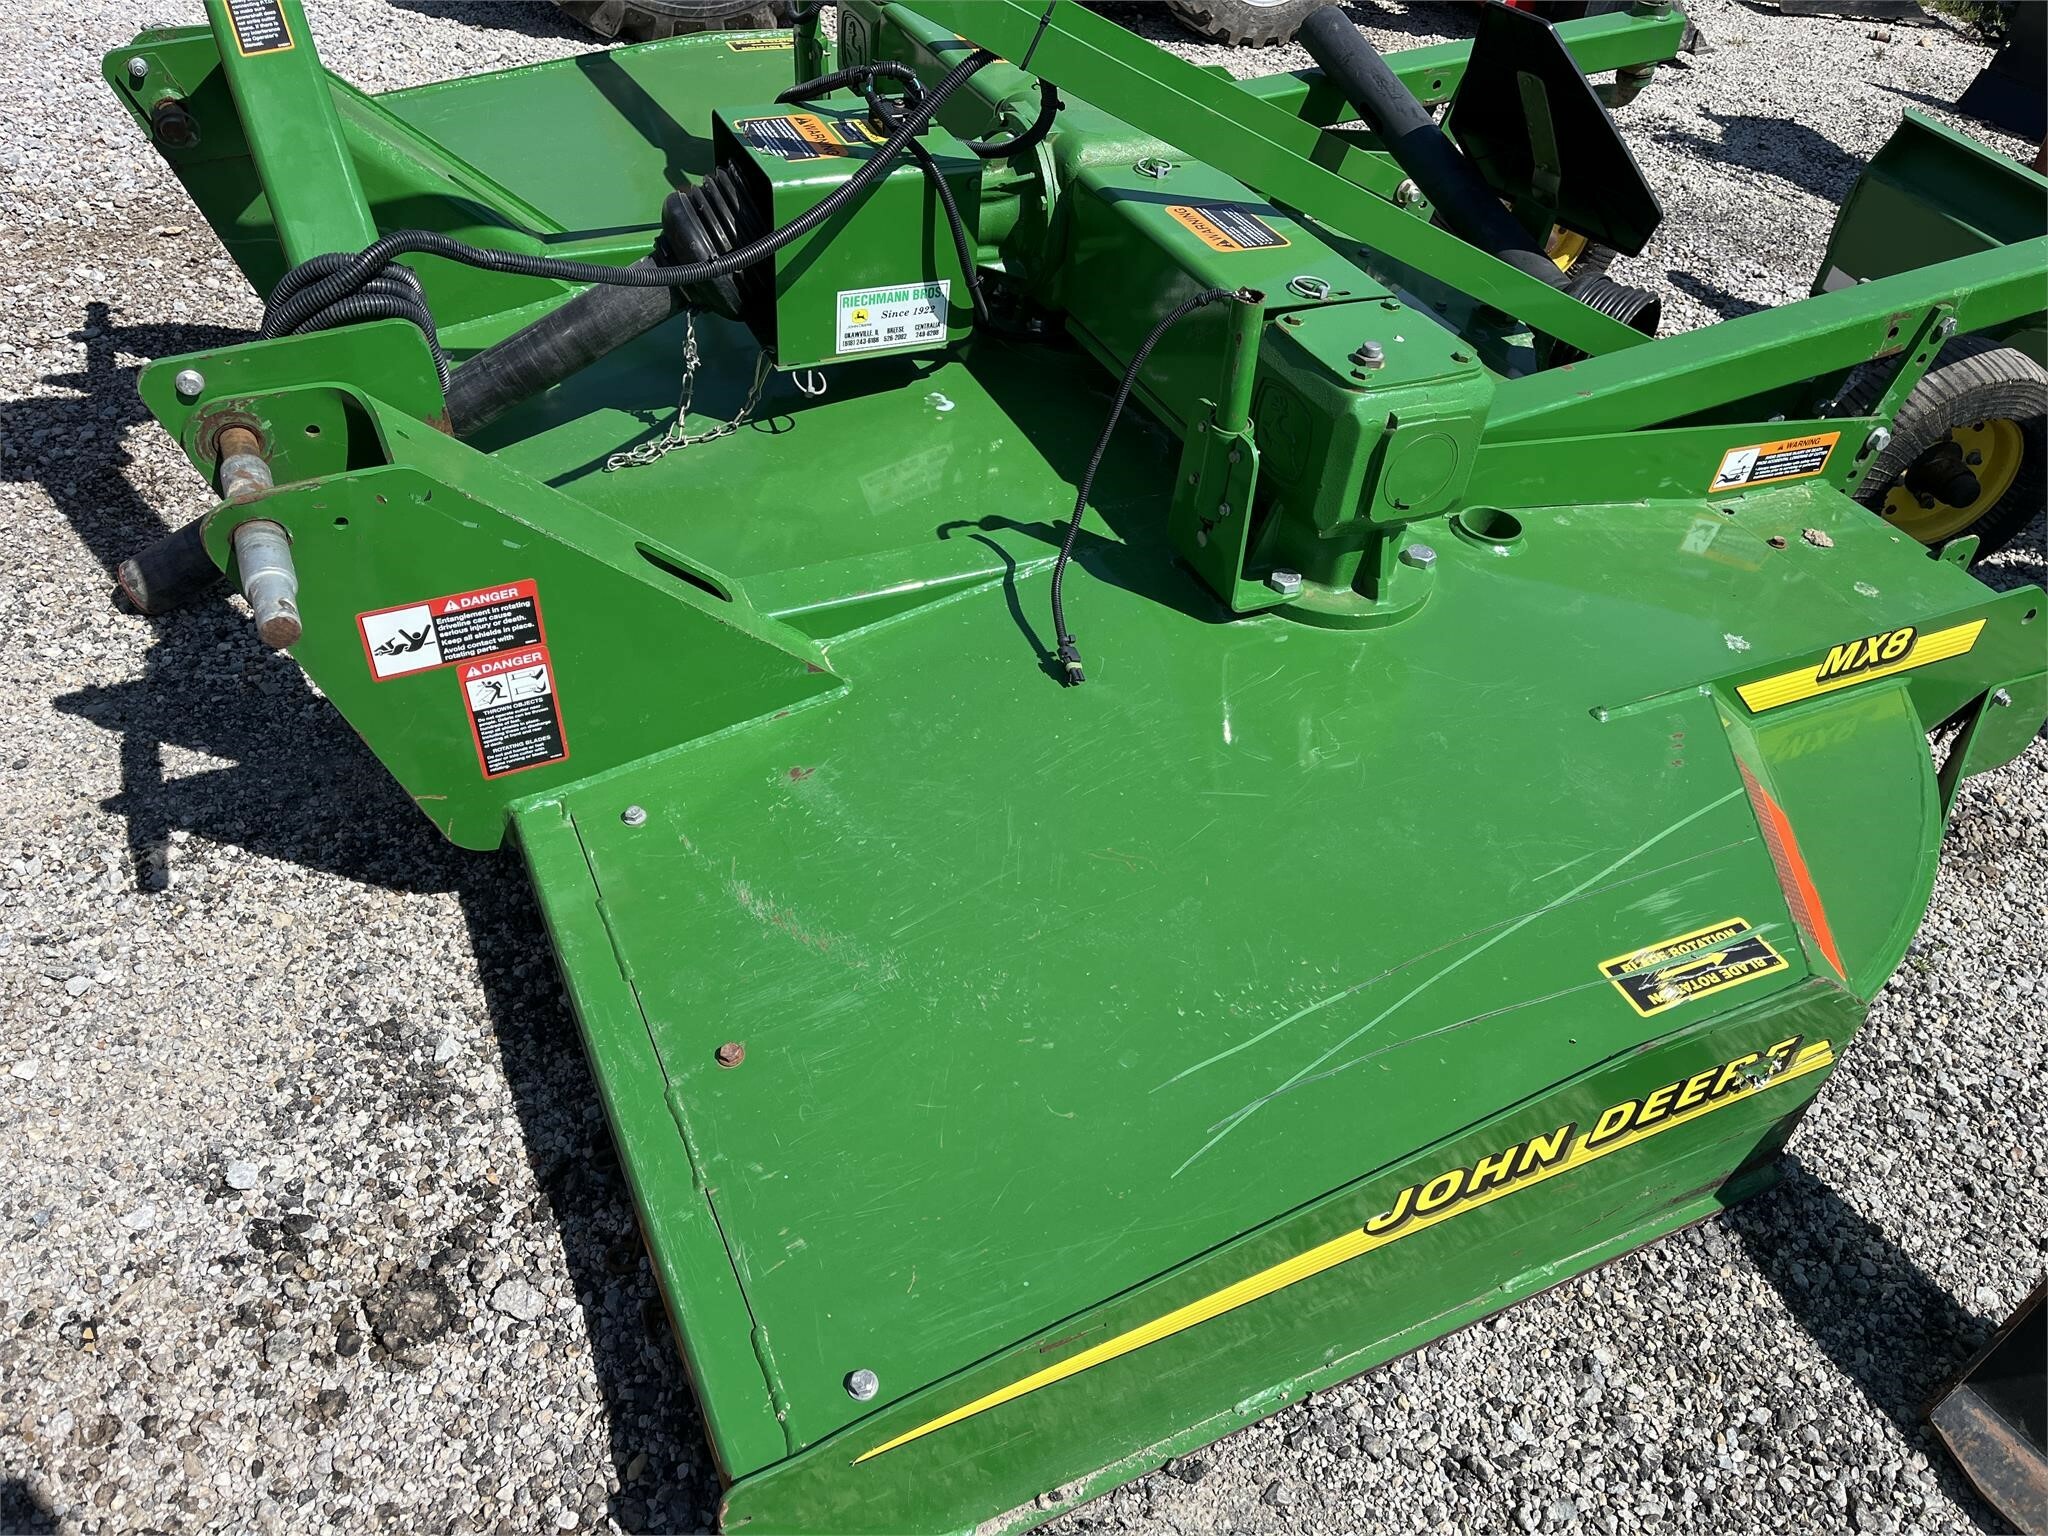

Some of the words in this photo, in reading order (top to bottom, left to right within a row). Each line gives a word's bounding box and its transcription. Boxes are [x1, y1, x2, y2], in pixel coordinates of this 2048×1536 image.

[804, 117, 840, 155] WARNING
[1174, 207, 1220, 241] WARNING
[842, 290, 910, 308] RIECHMANN
[913, 286, 944, 300] BROS.
[881, 308, 910, 319] Since
[913, 305, 936, 315] 1922
[1786, 438, 1821, 449] WARNING
[460, 588, 519, 608] DANGER
[436, 608, 491, 625] Entanglement
[501, 600, 531, 612] rotating
[438, 619, 471, 631] driveline
[489, 612, 512, 620] cause
[440, 628, 468, 638] serious
[470, 623, 491, 632] injury
[503, 615, 527, 624] death.
[441, 637, 462, 646] Keep
[464, 634, 473, 642] all
[474, 628, 502, 639] shields
[512, 622, 535, 632] place.
[444, 645, 465, 655] Avoid
[467, 638, 497, 649] contact
[497, 634, 514, 643] with
[445, 650, 476, 661] rotating
[476, 646, 499, 655] parts.
[1816, 626, 1917, 684] MX8
[481, 652, 542, 673] DANGER
[483, 705, 512, 716] THROWN
[513, 697, 544, 709] OBJECTS
[492, 741, 524, 753] ROTATING
[525, 735, 551, 745] BLADES
[1671, 928, 1737, 958] ROTATION
[1719, 957, 1768, 980] BLADE
[1364, 1122, 1577, 1235] JOHN
